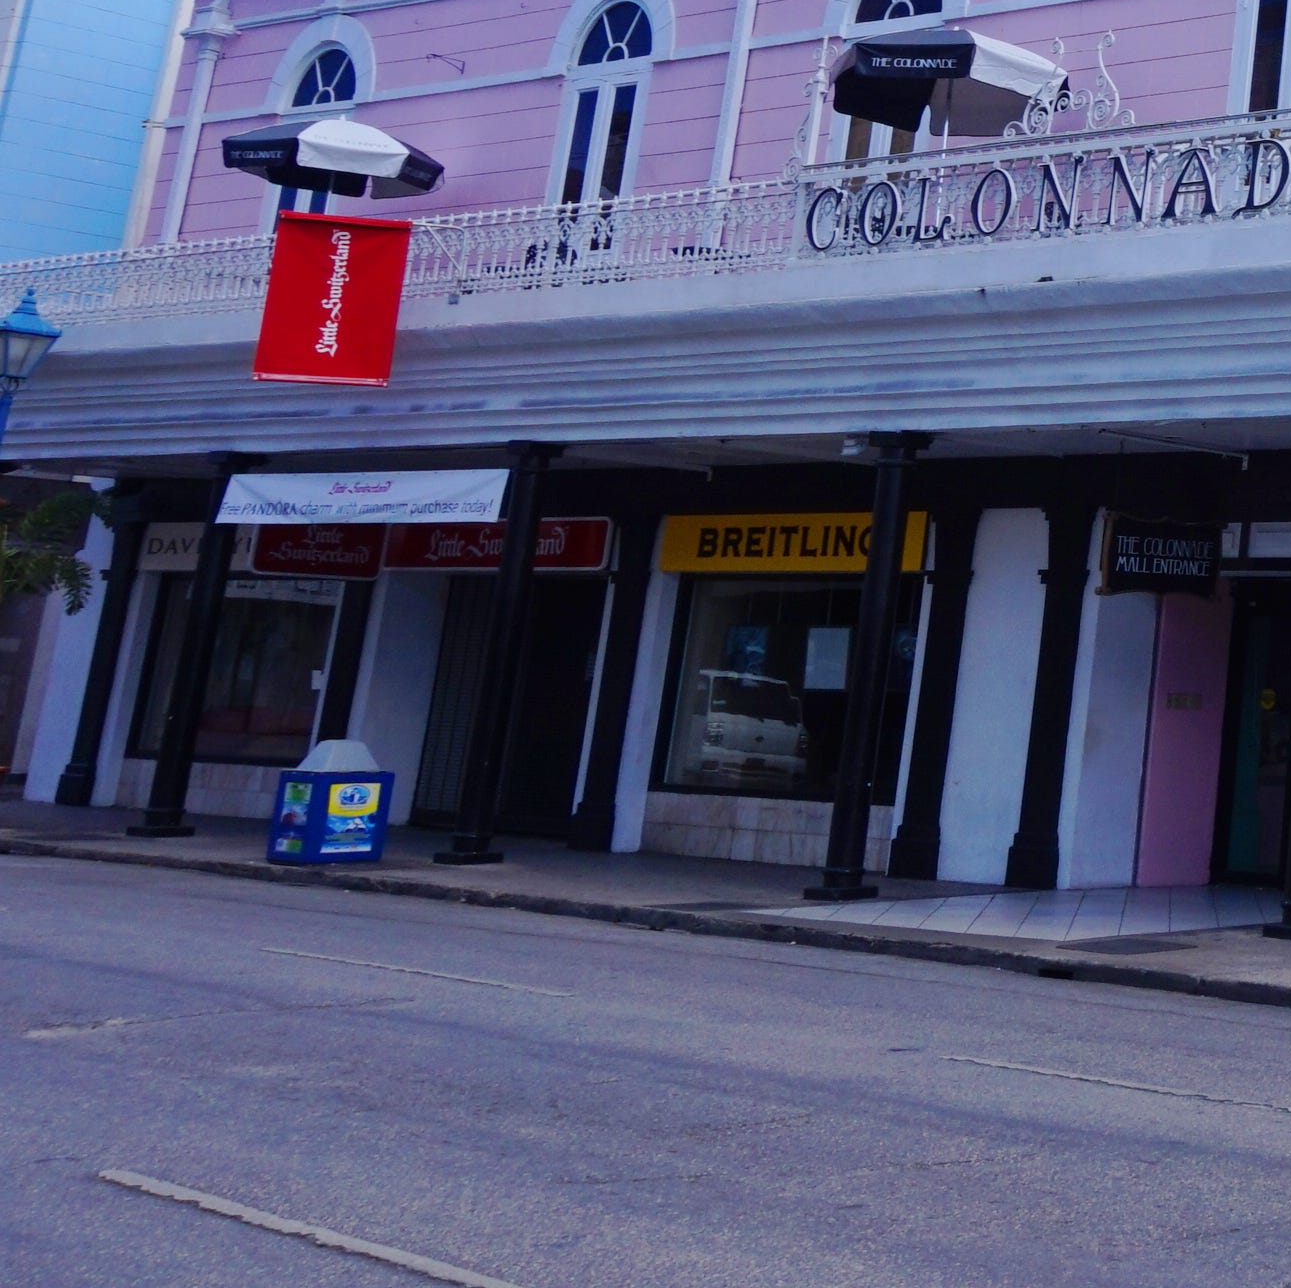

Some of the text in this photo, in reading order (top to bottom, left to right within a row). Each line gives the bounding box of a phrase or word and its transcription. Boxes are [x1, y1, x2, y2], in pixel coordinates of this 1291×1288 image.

[871, 57, 958, 69] THE COLONNADE
[315, 230, 351, 357] Little Switzerland
[241, 501, 299, 516] PANDORA
[409, 500, 459, 516] purchase
[147, 537, 200, 555] DAV
[268, 540, 370, 565] Switzerland
[424, 529, 465, 561] Little
[1117, 536, 1215, 560] THE COLONNADE
[1115, 556, 1209, 576] MALL ENTRANCE
